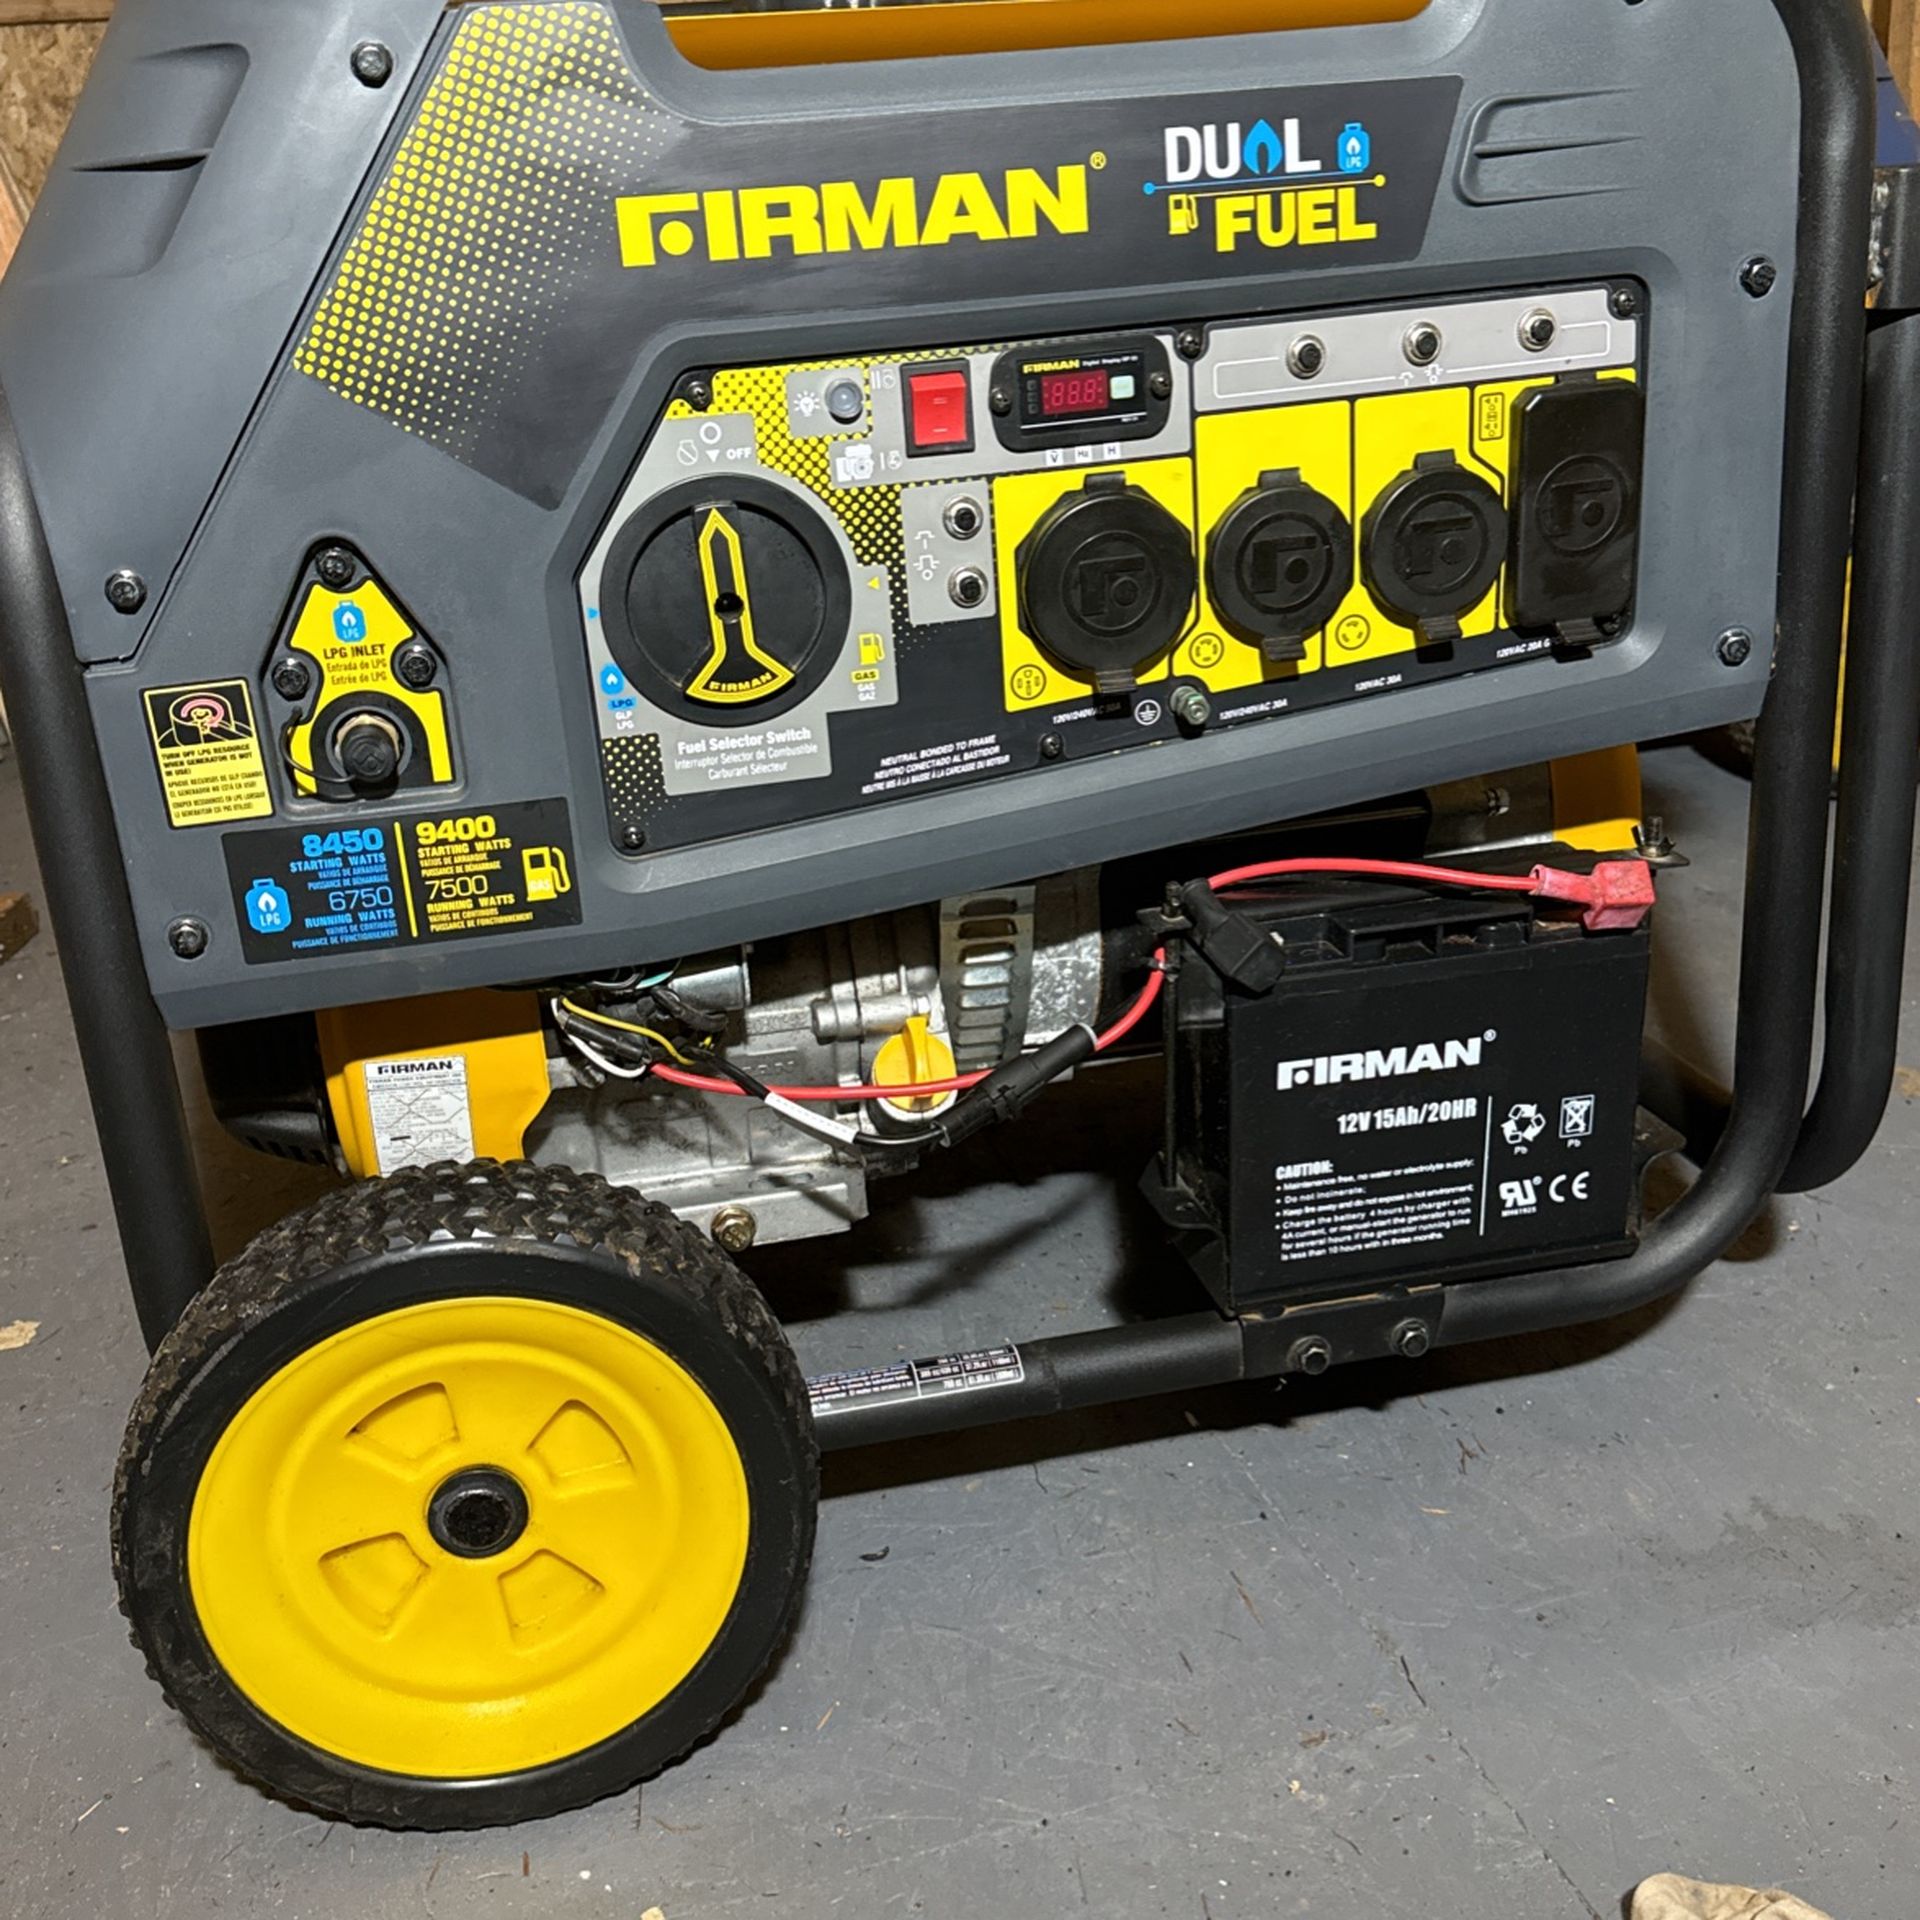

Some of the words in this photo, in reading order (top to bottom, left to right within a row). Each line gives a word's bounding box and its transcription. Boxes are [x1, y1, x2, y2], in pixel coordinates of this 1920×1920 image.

[1164, 118, 1322, 183] DUAL
[616, 165, 1089, 267] FIRMAN
[1215, 187, 1377, 252] FUEL
[1022, 359, 1080, 374] FIRMAN
[726, 447, 752, 461] OFF
[323, 646, 347, 660] LPG
[351, 643, 386, 658] INLET
[326, 661, 357, 673] Entrada
[360, 661, 369, 670] de
[373, 659, 387, 669] LPG
[854, 671, 877, 680] GAS
[360, 673, 369, 683] de
[373, 671, 387, 682] LPG
[709, 672, 772, 692] FIRMAN
[611, 698, 634, 708] LPG
[678, 740, 706, 755] Fuel
[708, 733, 764, 751] Selector
[766, 726, 812, 744] Switch
[880, 752, 918, 767] NEUTRAL
[920, 744, 955, 759] BONDED
[956, 741, 966, 750] TO
[968, 734, 996, 748] FRAME
[674, 756, 718, 770] Interruptor
[720, 751, 753, 765] Selector
[756, 749, 766, 760] de
[768, 743, 818, 758] Combustible
[708, 766, 749, 780] Carburant
[415, 815, 496, 845] 9400
[302, 827, 384, 857] 8450
[417, 843, 469, 858] STARTING
[474, 837, 512, 852] WATTS
[289, 857, 342, 873] STARTING
[348, 852, 386, 866] WATTS
[425, 875, 488, 900] 7500
[329, 886, 393, 911] 6750
[427, 899, 473, 913] RUNNING
[478, 894, 515, 907] WATTS
[259, 913, 281, 927] LPG
[304, 913, 353, 928] RUNNING
[358, 908, 395, 921] WATTS
[377, 1060, 453, 1075] FIRMAN
[1276, 1036, 1482, 1091] FIRMAN
[1337, 1111, 1371, 1134] 12V
[1373, 1097, 1478, 1130] 15Ah/20HR
[1514, 1145, 1528, 1155] Pb
[1567, 1139, 1581, 1149] Pb
[1275, 1160, 1334, 1180] CAUTION:
[1283, 1178, 1336, 1190] Maintenance
[1284, 1195, 1298, 1204] Do
[1299, 1193, 1315, 1201] not
[1282, 1219, 1315, 1229] Charge
[1317, 1216, 1332, 1224] the
[1333, 1212, 1366, 1222] battery
[1377, 1207, 1402, 1216] hours
[1404, 1205, 1415, 1213] by
[1417, 1200, 1451, 1210] charger
[1452, 1196, 1471, 1205] with
[1418, 1221, 1451, 1231] running
[1452, 1218, 1471, 1226] time
[1281, 1232, 1294, 1240] 4A
